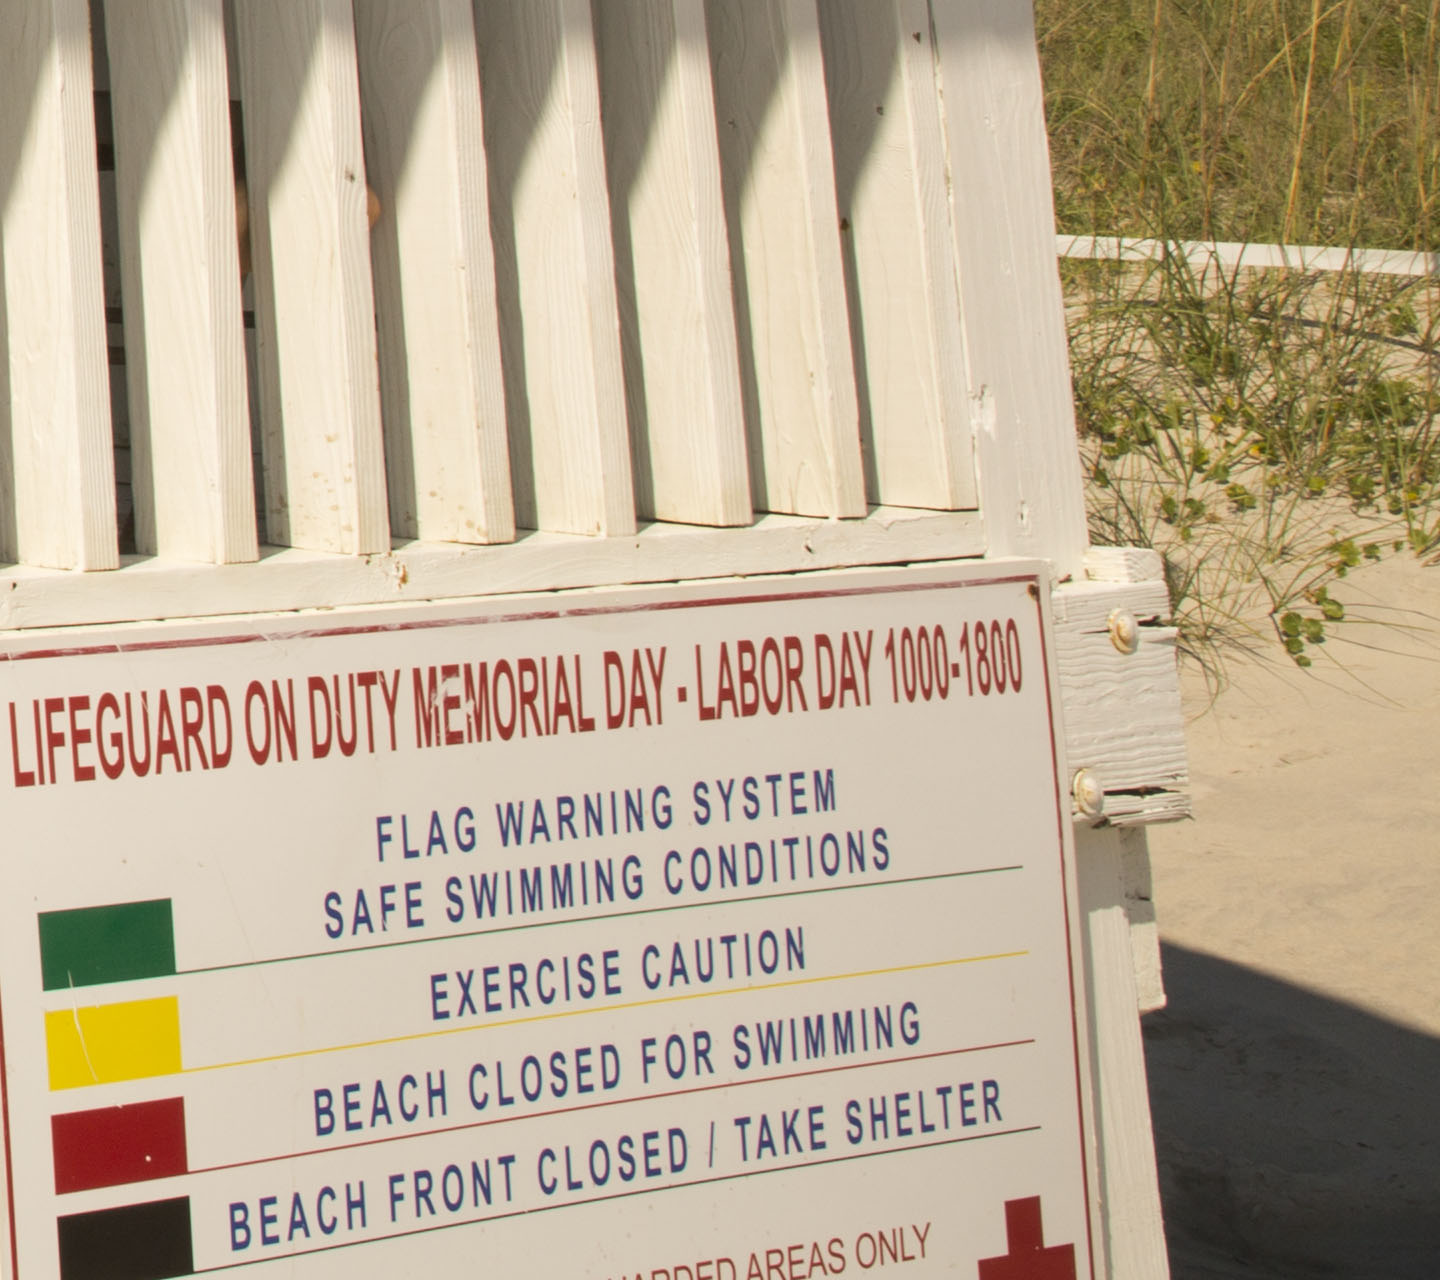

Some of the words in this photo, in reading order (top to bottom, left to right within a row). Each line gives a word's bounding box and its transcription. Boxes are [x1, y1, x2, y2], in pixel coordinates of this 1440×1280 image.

[9, 684, 233, 788] LIFEGUARD
[244, 678, 298, 766] ON
[307, 669, 401, 759] DUTY
[412, 654, 596, 749] MEMORIAL
[603, 646, 667, 730] DAY
[695, 636, 809, 721] LABOR
[814, 629, 873, 711] DAY
[884, 617, 1023, 704] 1000-1800
[376, 806, 476, 862] FLAG
[495, 785, 673, 847] WARNING
[693, 768, 836, 826] SYSTEM
[324, 881, 425, 939] SAFE
[445, 854, 643, 923] SWIMMING
[663, 827, 889, 895] CONDITIONS
[430, 949, 622, 1021] EXERCISE
[641, 926, 805, 990] CAUTION
[313, 1069, 447, 1137] BEACH
[468, 1043, 620, 1111] CLOSED
[641, 1030, 714, 1084] FOR
[732, 1001, 920, 1070] SWIMMING
[229, 1180, 367, 1251] BEACH
[388, 1154, 516, 1222] FRONT
[537, 1127, 688, 1196] CLOSED
[733, 1105, 827, 1162] TAKE
[845, 1079, 1002, 1145] SHELTER
[746, 1238, 845, 1280] AREAS
[855, 1221, 932, 1270] ONLY
